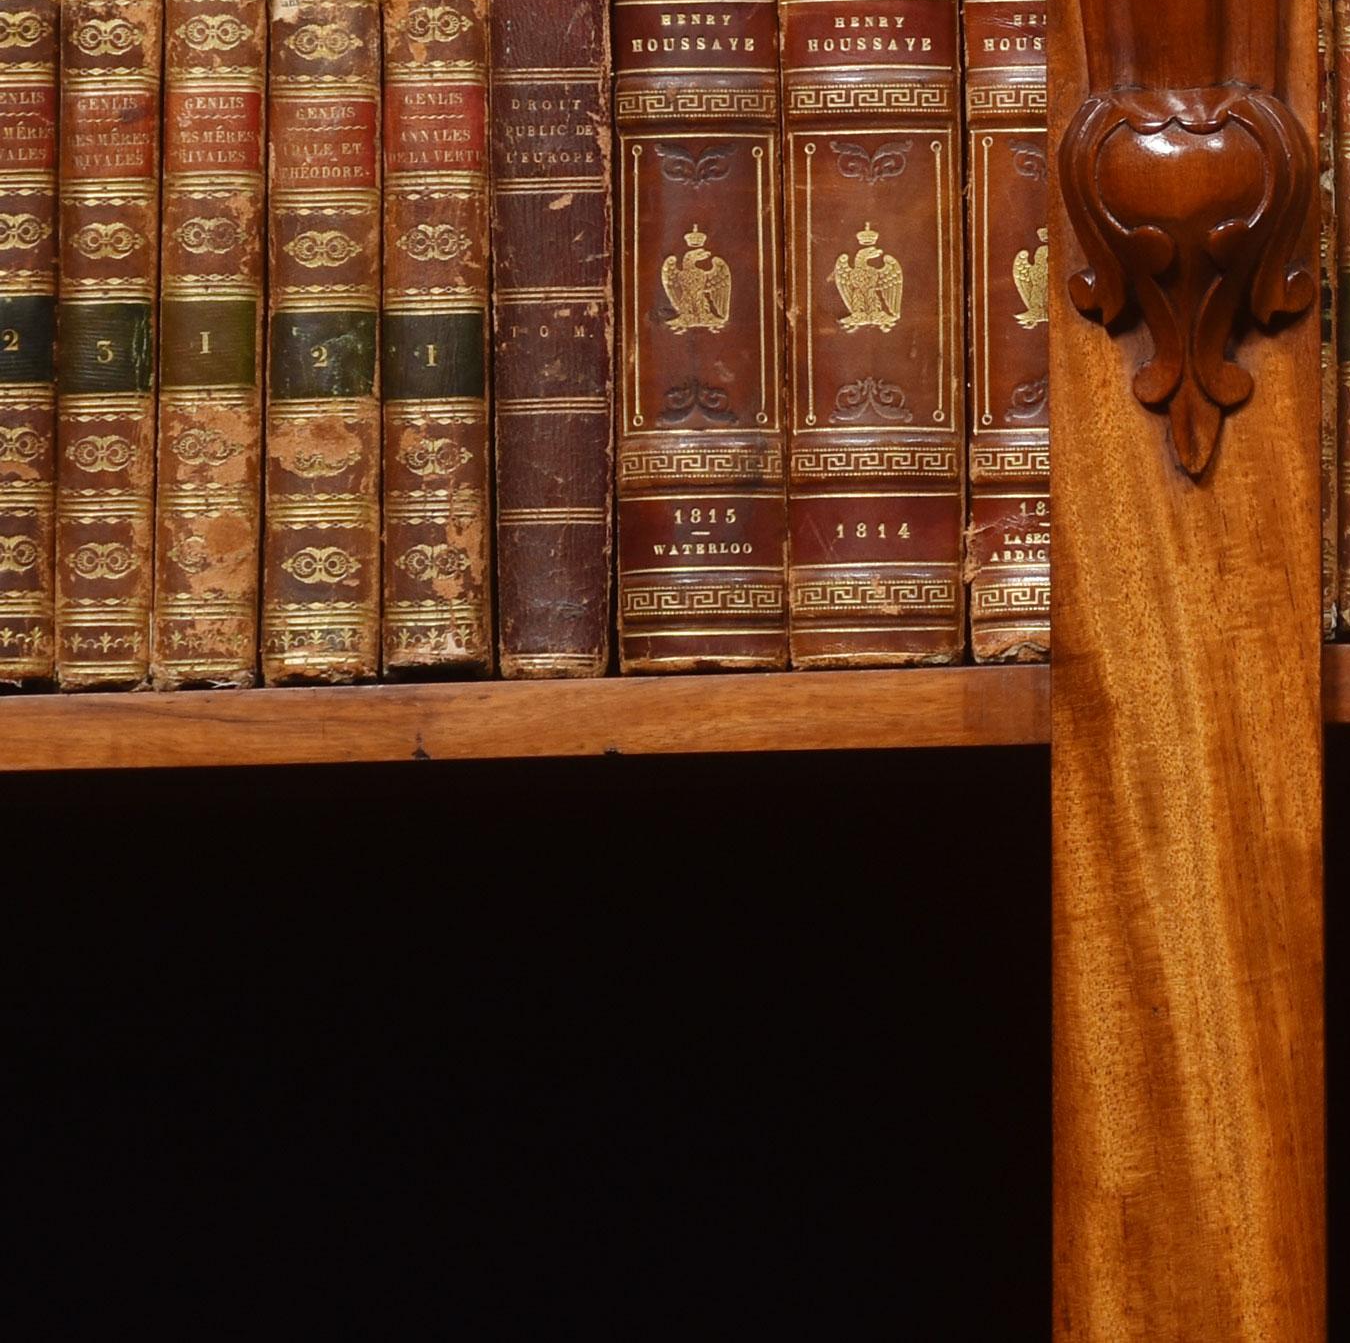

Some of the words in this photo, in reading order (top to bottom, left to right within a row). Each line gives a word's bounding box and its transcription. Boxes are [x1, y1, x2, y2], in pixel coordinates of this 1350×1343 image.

[661, 14, 732, 26] HENRY
[835, 16, 905, 28] HENRY
[632, 38, 755, 52] HOUSSAYE
[807, 37, 932, 52] HOUSSAYE
[983, 37, 1043, 51] HOUS
[0, 92, 45, 105] ENLIS
[77, 97, 138, 111] GENLIS
[185, 96, 244, 109] GENLIS
[405, 92, 463, 105] GENLIS
[511, 99, 582, 110] DROIT
[296, 107, 356, 120] GENLIS
[401, 129, 471, 142] ANNALES
[505, 126, 568, 137] PUBLIC
[576, 125, 595, 136] DE
[342, 142, 362, 155] ET
[410, 151, 429, 164] LA
[507, 151, 595, 164] L'EUROPE
[3, 328, 20, 351] 2
[96, 340, 114, 363] 3
[310, 345, 328, 368] 2
[1020, 501, 1046, 516] 18
[674, 508, 737, 524] 1815
[836, 522, 911, 539] 1814
[1004, 533, 1021, 545] LA
[653, 543, 753, 556] WATERLOO
[990, 550, 1047, 562] ABDIC
